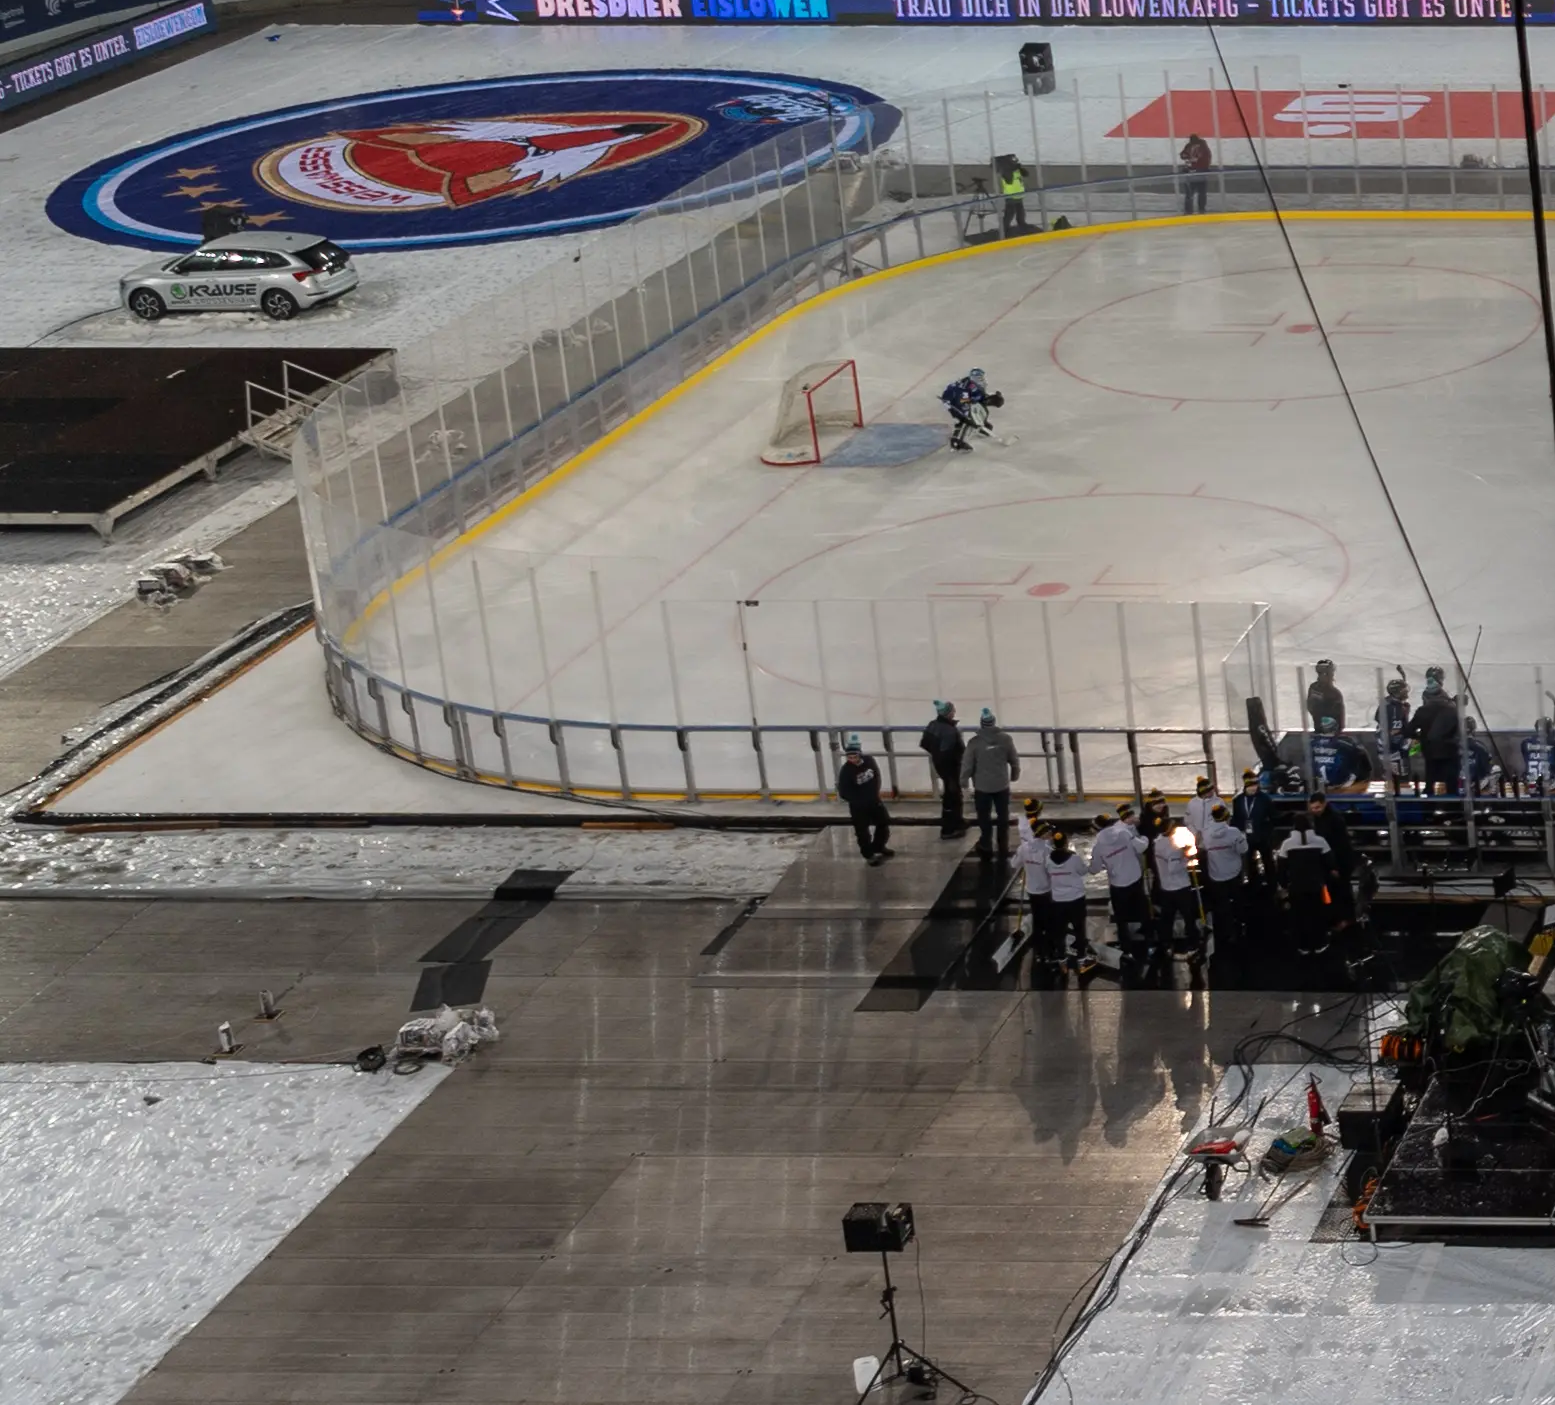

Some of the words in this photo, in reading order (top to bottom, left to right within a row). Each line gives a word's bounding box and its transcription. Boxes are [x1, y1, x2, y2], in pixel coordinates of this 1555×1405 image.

[10, 62, 55, 93] TICKETS
[55, 53, 79, 80] GIBT
[80, 47, 92, 68] ES
[93, 35, 131, 64] UNTER:
[189, 283, 257, 298] KRAUSE
